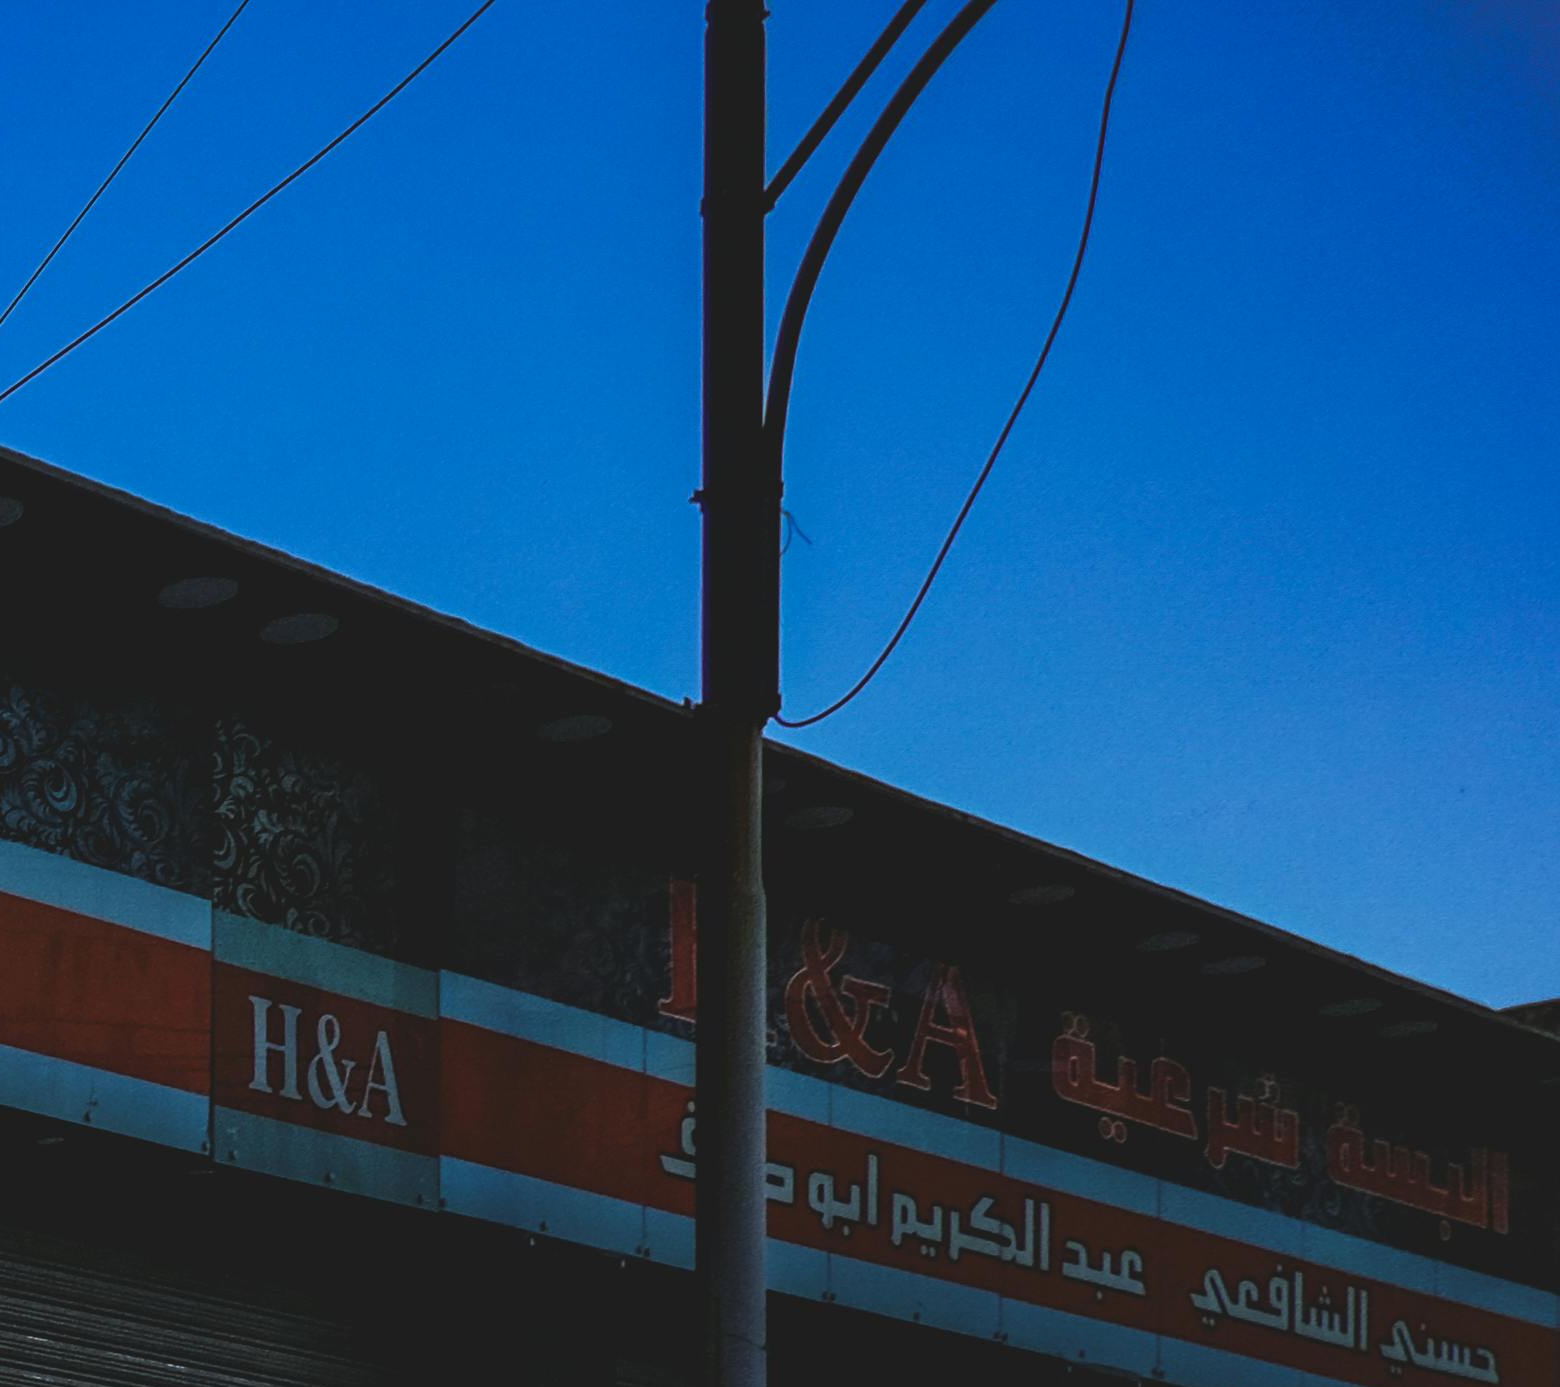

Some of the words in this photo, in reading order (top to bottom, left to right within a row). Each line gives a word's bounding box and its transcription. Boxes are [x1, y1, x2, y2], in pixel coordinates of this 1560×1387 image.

[248, 994, 408, 1130] H&A
[807, 1152, 880, 1237] ابو
[890, 1195, 1051, 1272] الكريم
[1061, 1236, 1146, 1300] عبد
[1189, 1264, 1368, 1352] الشافعي
[1379, 1319, 1500, 1384] حسني
